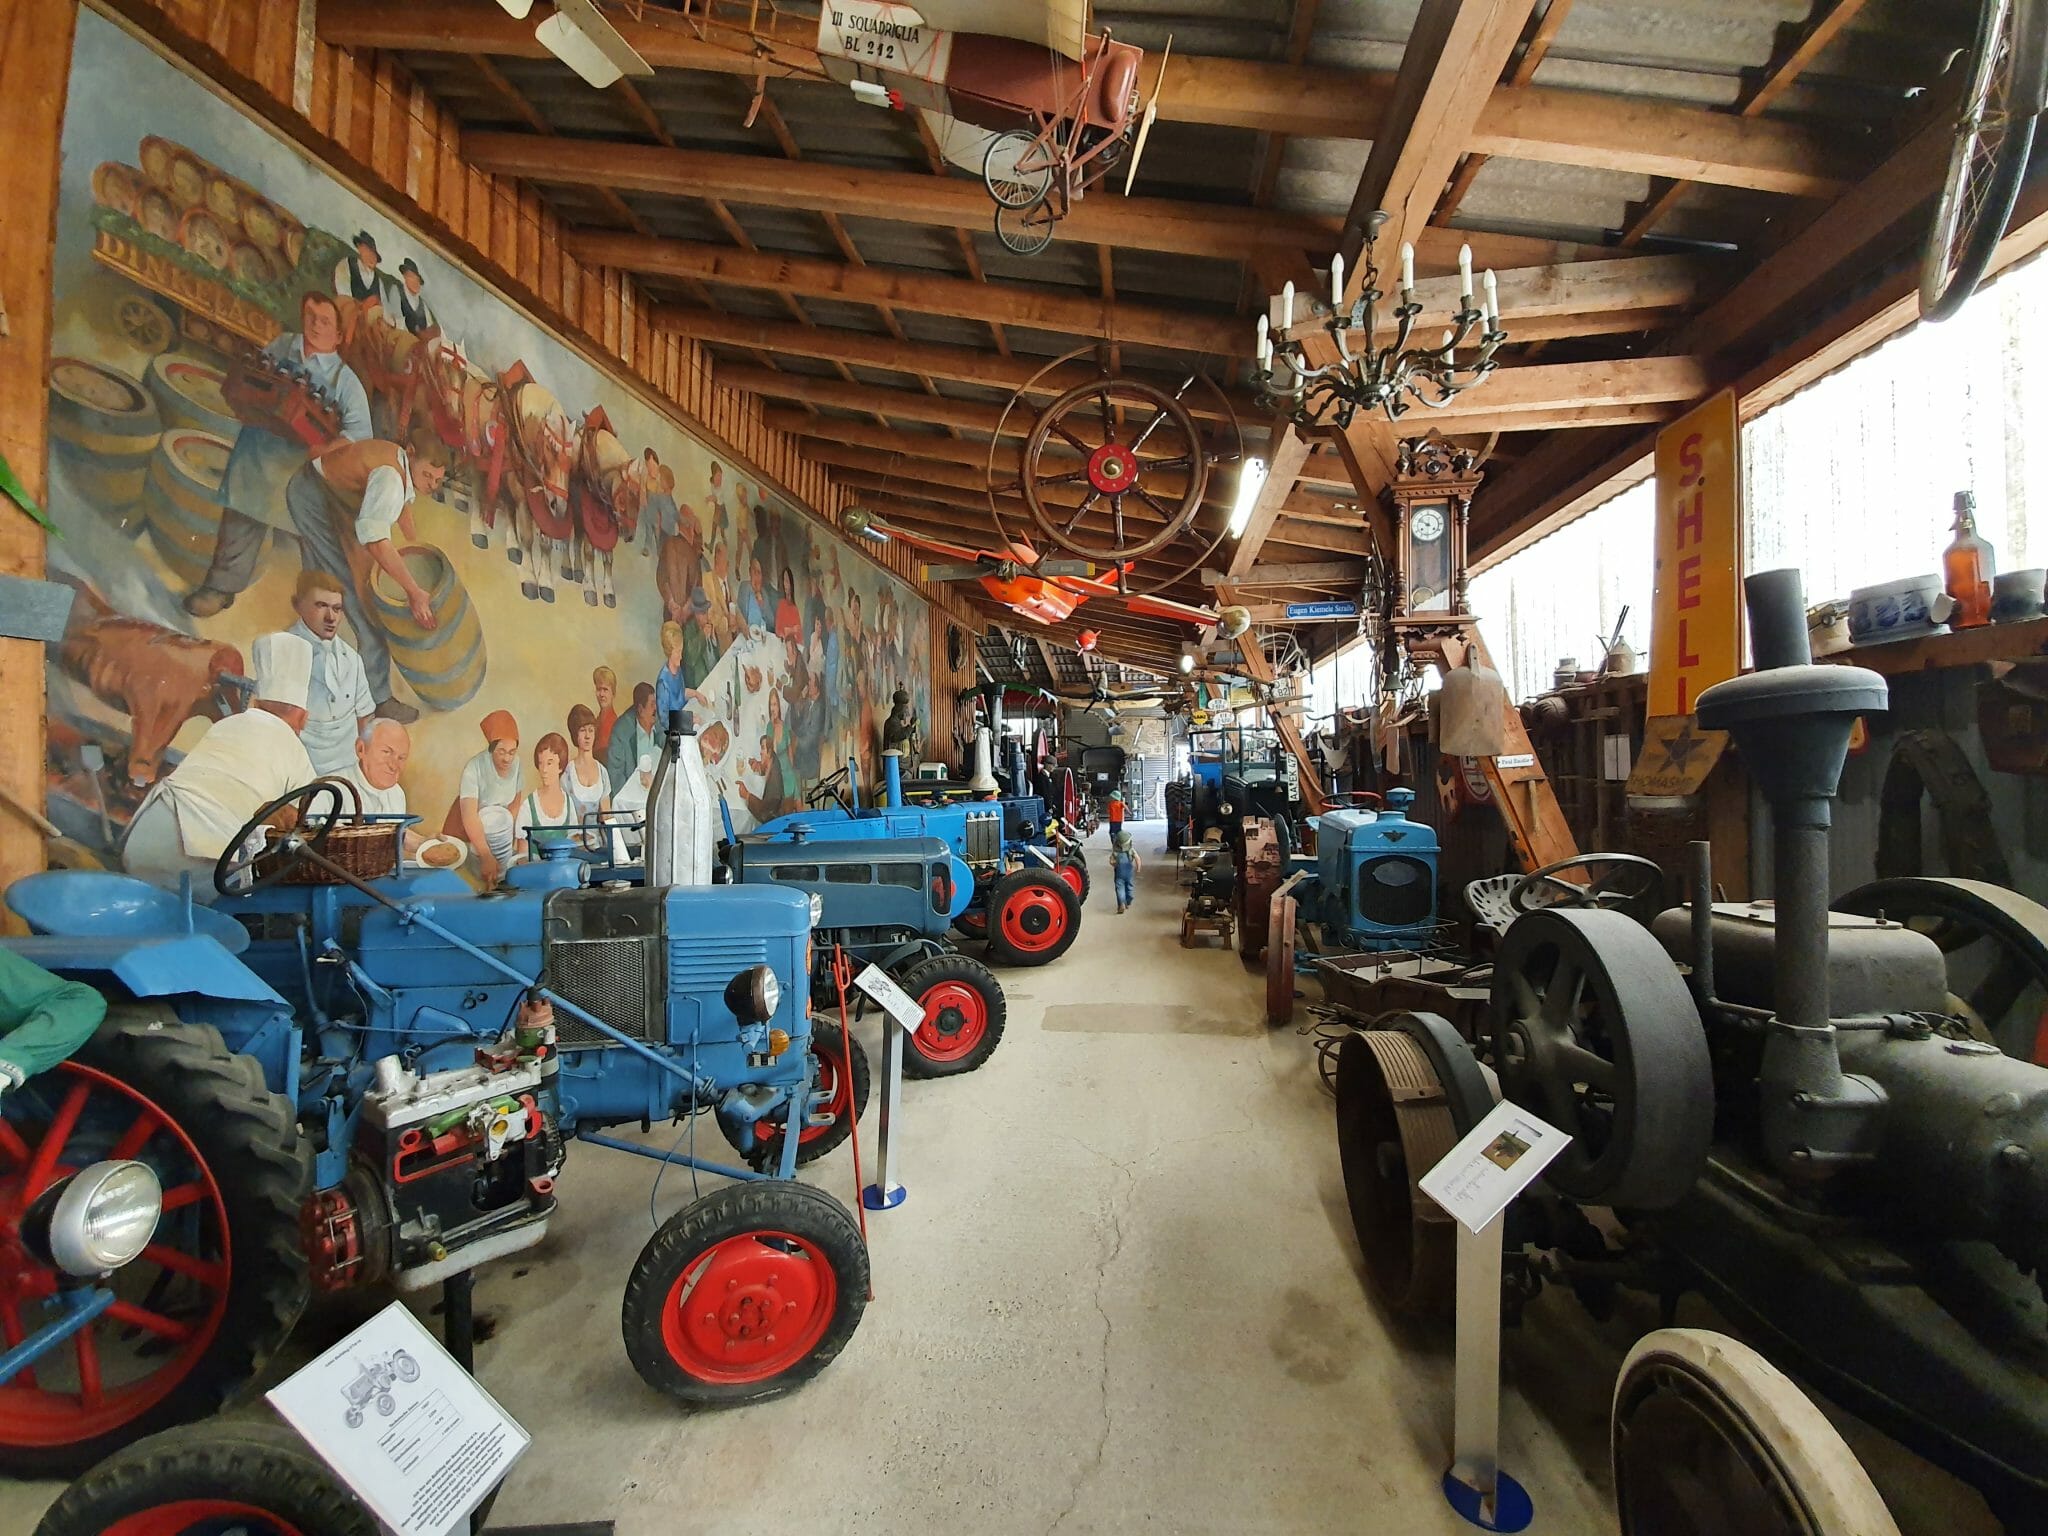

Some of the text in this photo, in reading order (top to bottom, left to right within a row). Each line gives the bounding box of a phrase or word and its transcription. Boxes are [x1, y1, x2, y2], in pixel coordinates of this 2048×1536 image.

[848, 14, 919, 44] SQUADRIGLIA
[845, 35, 860, 52] BL
[1289, 606, 1308, 615] Eugen
[1309, 604, 1334, 613] Kiemele
